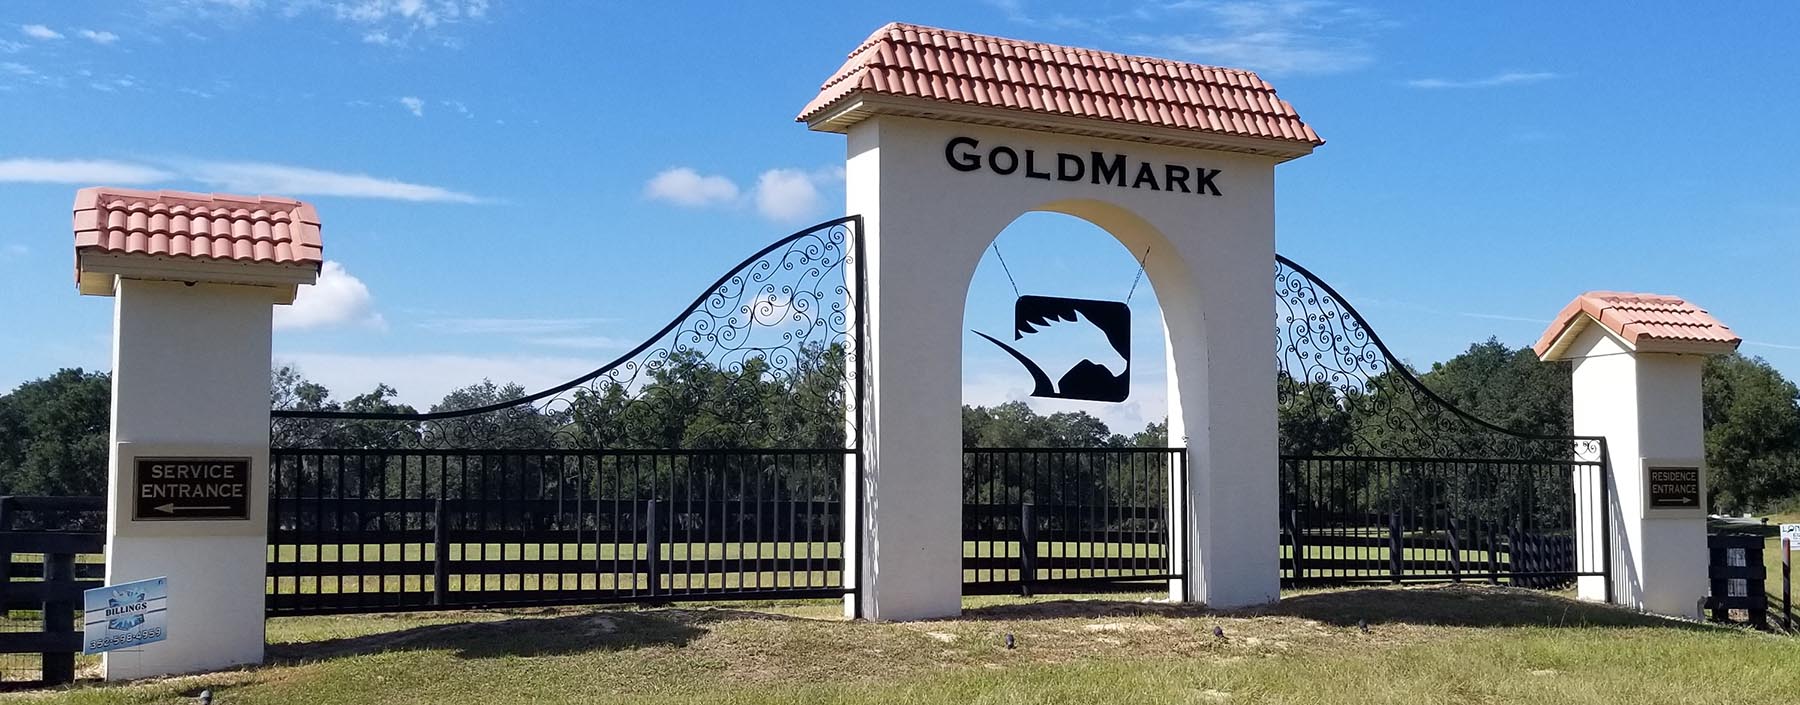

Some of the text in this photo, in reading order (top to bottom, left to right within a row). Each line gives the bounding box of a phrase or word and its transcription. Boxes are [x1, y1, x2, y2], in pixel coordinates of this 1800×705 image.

[945, 136, 1222, 196] GOLDMARK
[151, 464, 234, 479] SERVICE
[1652, 471, 1696, 481] RESIDENCE
[142, 483, 243, 498] ENTRANCE
[1652, 484, 1696, 494] ENTRANCE
[105, 602, 147, 616] BILLINGS
